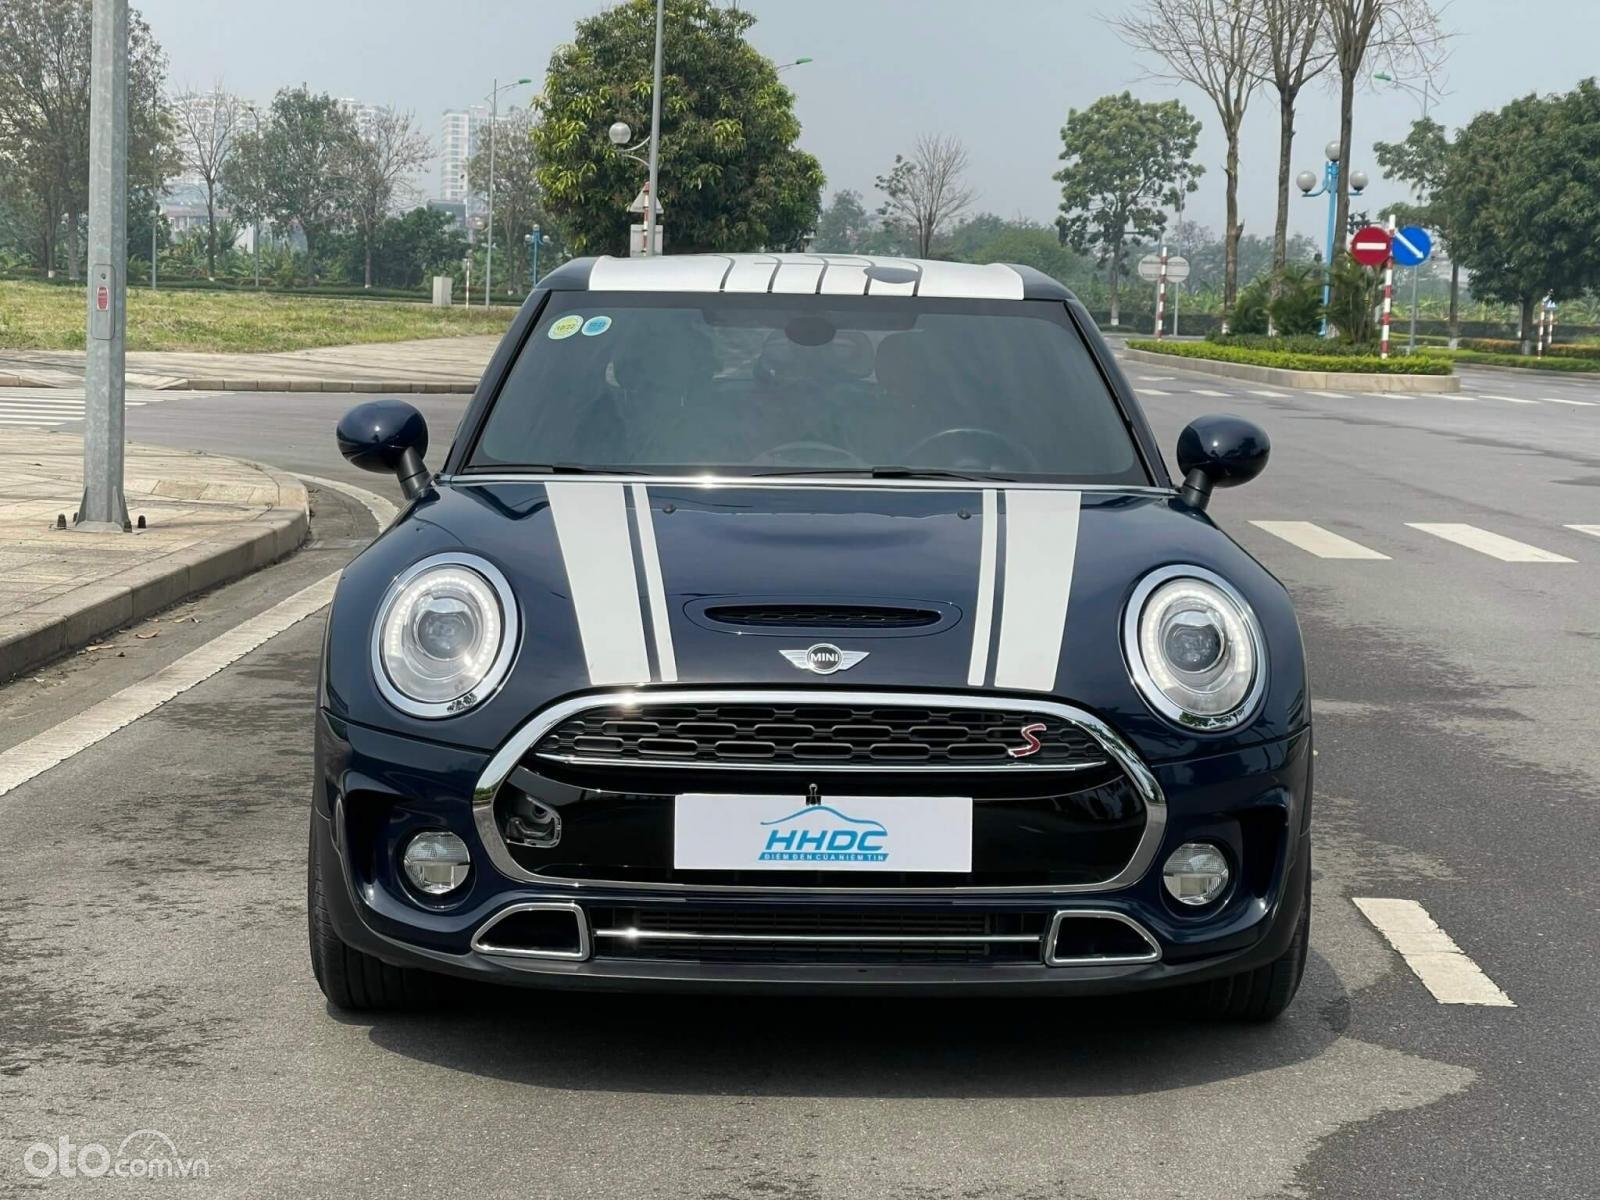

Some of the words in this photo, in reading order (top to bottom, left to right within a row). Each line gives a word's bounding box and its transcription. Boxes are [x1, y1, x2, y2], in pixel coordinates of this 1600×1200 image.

[810, 653, 839, 661] MINI
[1007, 723, 1047, 758] S
[765, 830, 888, 851] HHDC
